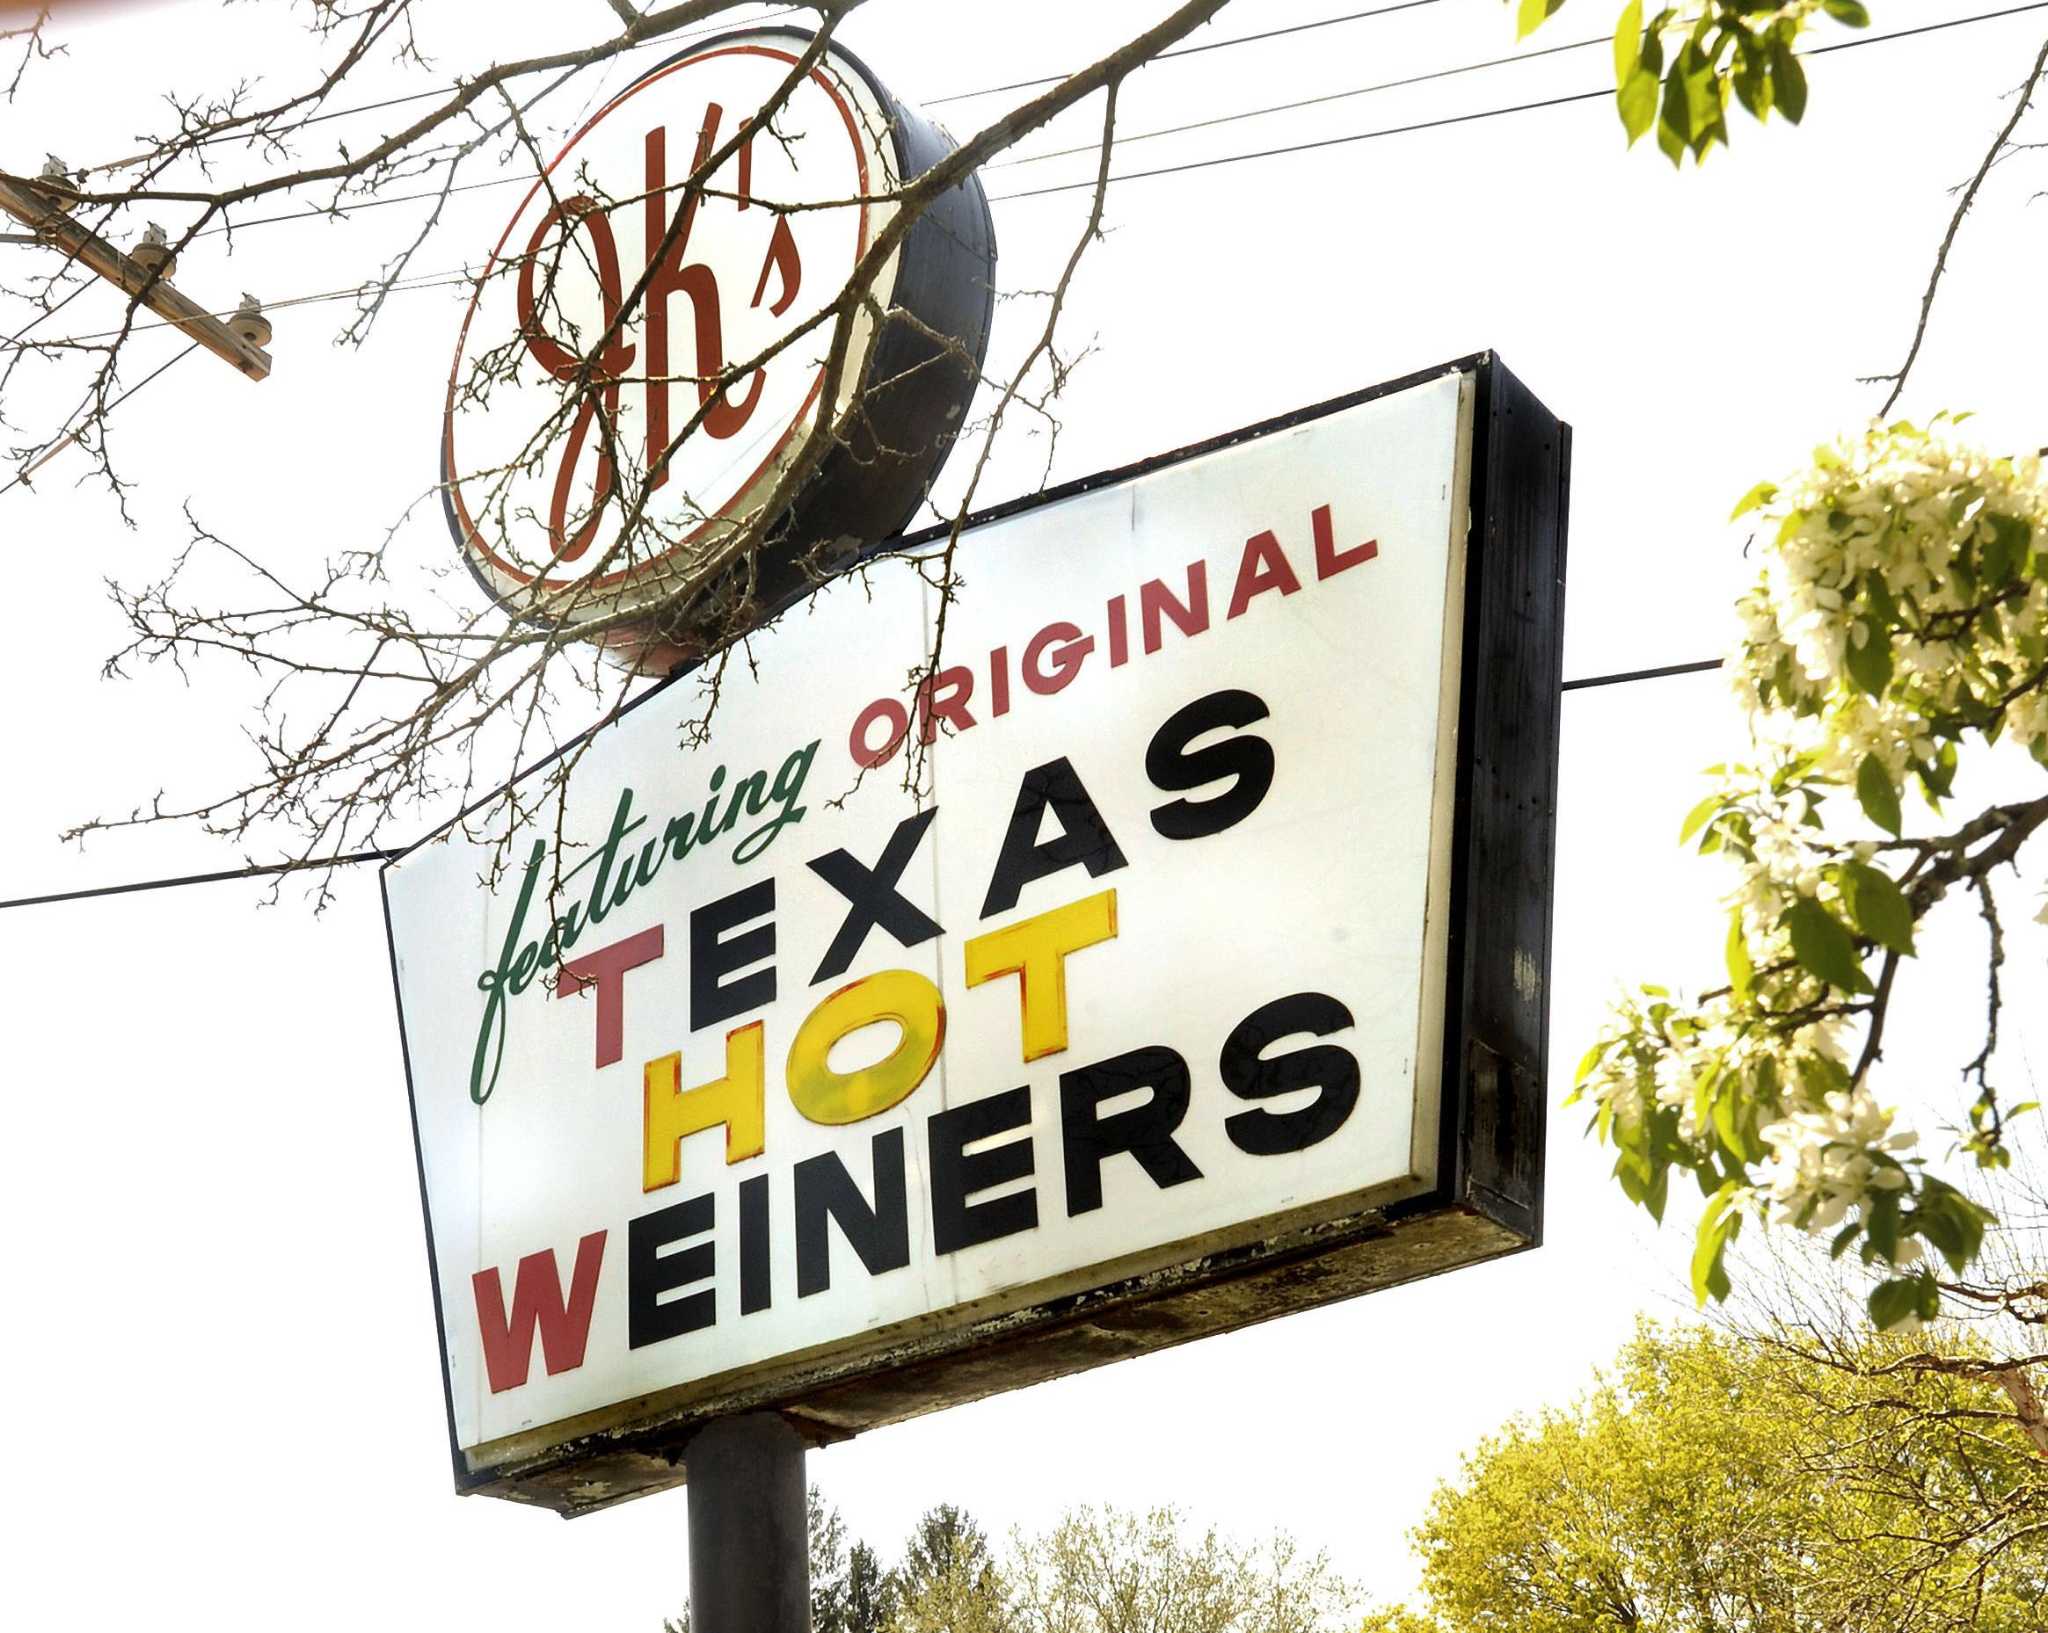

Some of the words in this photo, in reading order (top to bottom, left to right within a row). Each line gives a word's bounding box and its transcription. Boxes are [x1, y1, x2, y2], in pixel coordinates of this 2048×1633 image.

[470, 738, 822, 1105] featuring
[850, 504, 1379, 770] ORIGINAL
[558, 690, 1275, 1068] TEXAS
[473, 992, 1359, 1393] WEINERS
[643, 888, 1119, 1192] HOT
